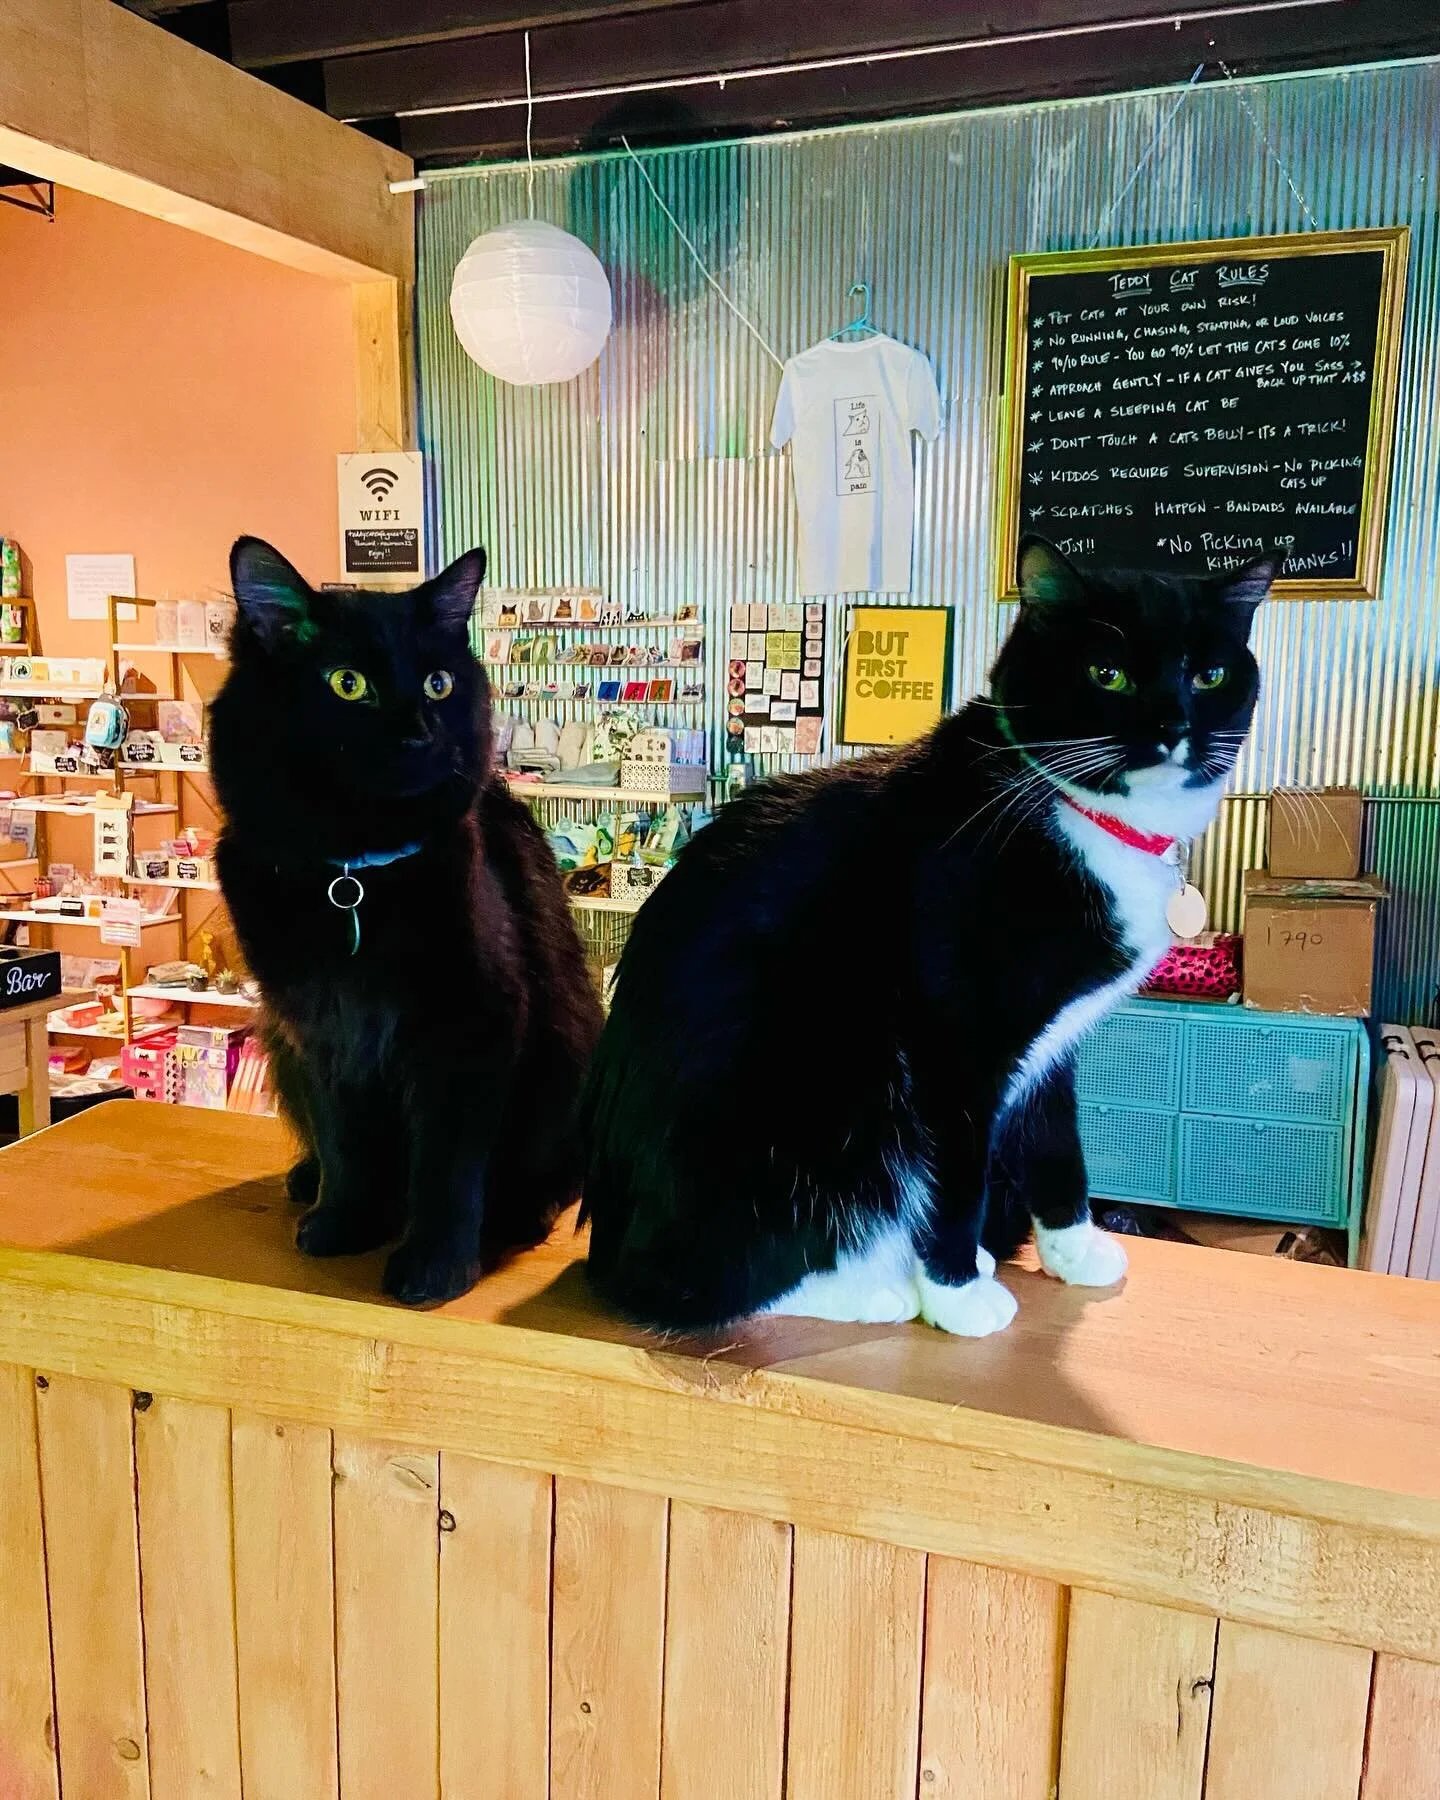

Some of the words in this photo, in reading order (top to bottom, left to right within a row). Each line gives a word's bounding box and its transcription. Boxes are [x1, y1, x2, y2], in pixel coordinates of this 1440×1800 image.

[1108, 272, 1151, 291] TEDDY
[1169, 269, 1200, 286] CAT
[1215, 264, 1269, 282] RULES
[1048, 311, 1073, 325] PET
[1080, 309, 1105, 321] CATS
[1115, 307, 1129, 317] AT
[1138, 303, 1170, 317] YOUR
[1181, 299, 1207, 311] OWN
[1217, 294, 1257, 307] RISK!
[1256, 317, 1269, 327] OR
[1274, 315, 1299, 328] LOUD
[1305, 311, 1344, 323] VOICES
[1051, 354, 1078, 373] 90/10
[1080, 352, 1111, 366] RULE
[1125, 346, 1145, 361] YOU
[1150, 348, 1166, 358] GO
[1170, 343, 1194, 359] 90%
[1198, 343, 1222, 356] LET
[1225, 341, 1249, 354] THE
[1292, 338, 1321, 351] COME
[1330, 333, 1351, 351] 10%
[1049, 381, 1103, 396] APPROACH
[1112, 372, 1162, 390] GENTLY
[1178, 371, 1190, 384] IF
[1206, 369, 1231, 382] CAT
[1235, 364, 1275, 378] GIVES
[1280, 360, 1305, 373] YOU
[1315, 360, 1344, 372] SASS
[1256, 377, 1286, 388] BACK
[1292, 376, 1307, 386] UP
[1308, 372, 1338, 385] THAT
[1341, 370, 1367, 384] A$$
[1048, 408, 1086, 422] LEAVE
[1093, 408, 1102, 419] A
[1110, 400, 1176, 418] SLEEPING
[1185, 399, 1209, 412] CAT
[1220, 397, 1240, 409] BE
[1050, 435, 1092, 450] DONT
[1097, 433, 1138, 447] TOUCH
[1148, 432, 1158, 444] A
[1168, 431, 1200, 444] CATS
[1283, 425, 1292, 438] A
[1297, 418, 1346, 436] TRICK!
[1051, 469, 1100, 483] KIDDOS
[1109, 466, 1169, 479] REQUIRE
[1280, 477, 1307, 489] CATS
[1310, 476, 1327, 487] UP
[850, 483, 867, 492] pain
[359, 510, 400, 521] WIFI
[1050, 503, 1134, 519] SCRATCHES
[1154, 501, 1207, 516] HAPPEN
[1226, 500, 1286, 513] BANDAIDS
[1295, 502, 1358, 515] AVAILABLE
[857, 630, 909, 656] BUT
[855, 658, 908, 678] FIRST
[855, 679, 935, 701] COFFEE
[1266, 926, 1324, 951] 1790
[7, 966, 52, 995] Bar
